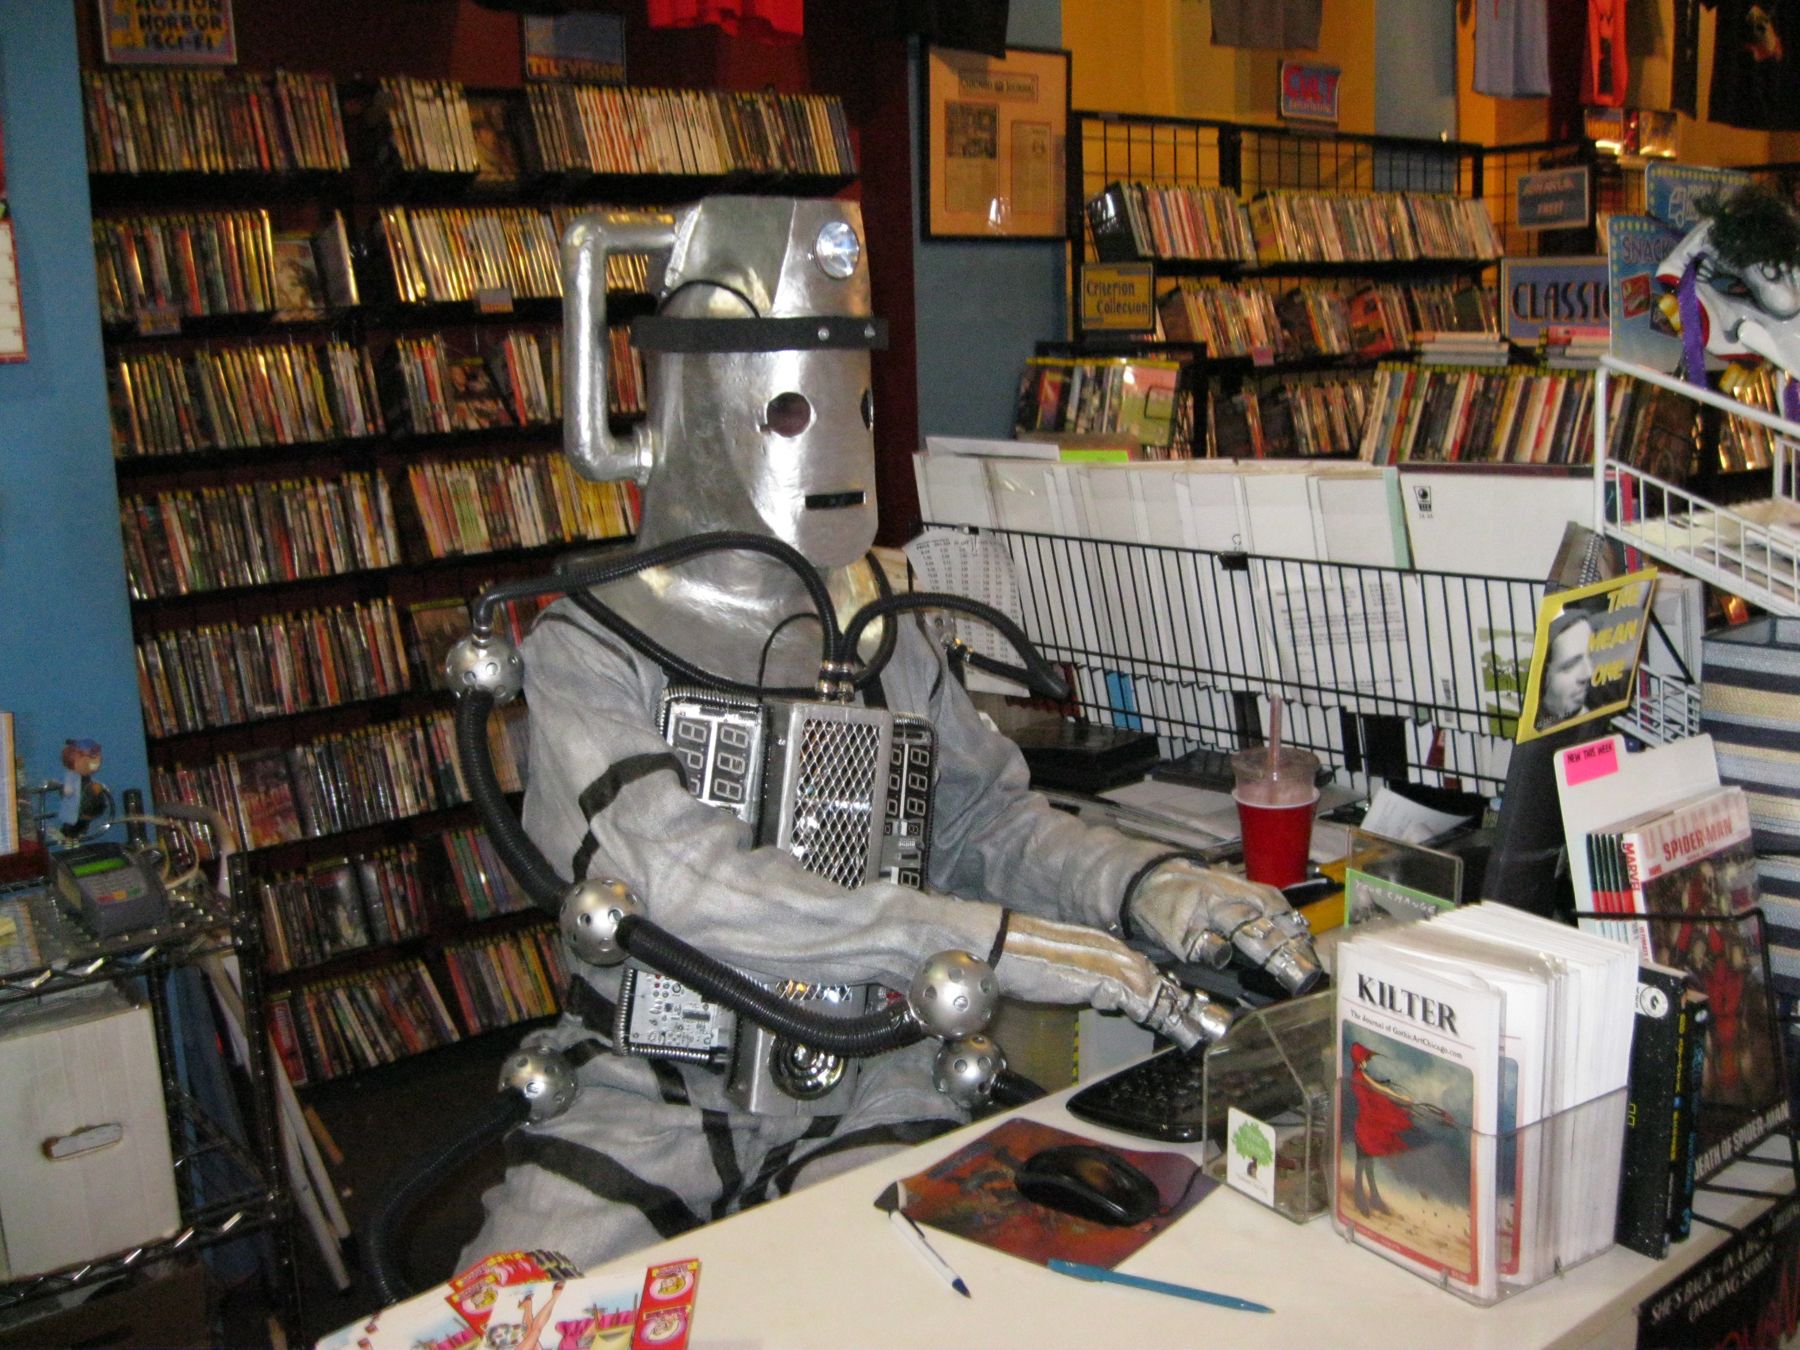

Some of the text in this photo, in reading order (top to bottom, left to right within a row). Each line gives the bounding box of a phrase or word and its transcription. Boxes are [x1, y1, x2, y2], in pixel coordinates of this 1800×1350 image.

[138, 13, 223, 32] HORROR
[528, 55, 625, 80] TELEVISION
[1284, 66, 1338, 103] CULT
[1086, 280, 1136, 297] Criterion
[1096, 300, 1149, 315] Collection
[1608, 584, 1642, 614] THE
[1591, 658, 1626, 687] ONE
[1567, 742, 1612, 764] NEW THIS WEEK
[1662, 817, 1733, 862] SPIDER-MAN
[1387, 891, 1436, 914] CHANGE
[1357, 972, 1460, 1038] KILTER
[1350, 1009, 1361, 1020] The
[1361, 1015, 1385, 1031] Journal
[1721, 1136, 1733, 1161] OF
[1732, 1099, 1790, 1153] SPIDER-MAN
